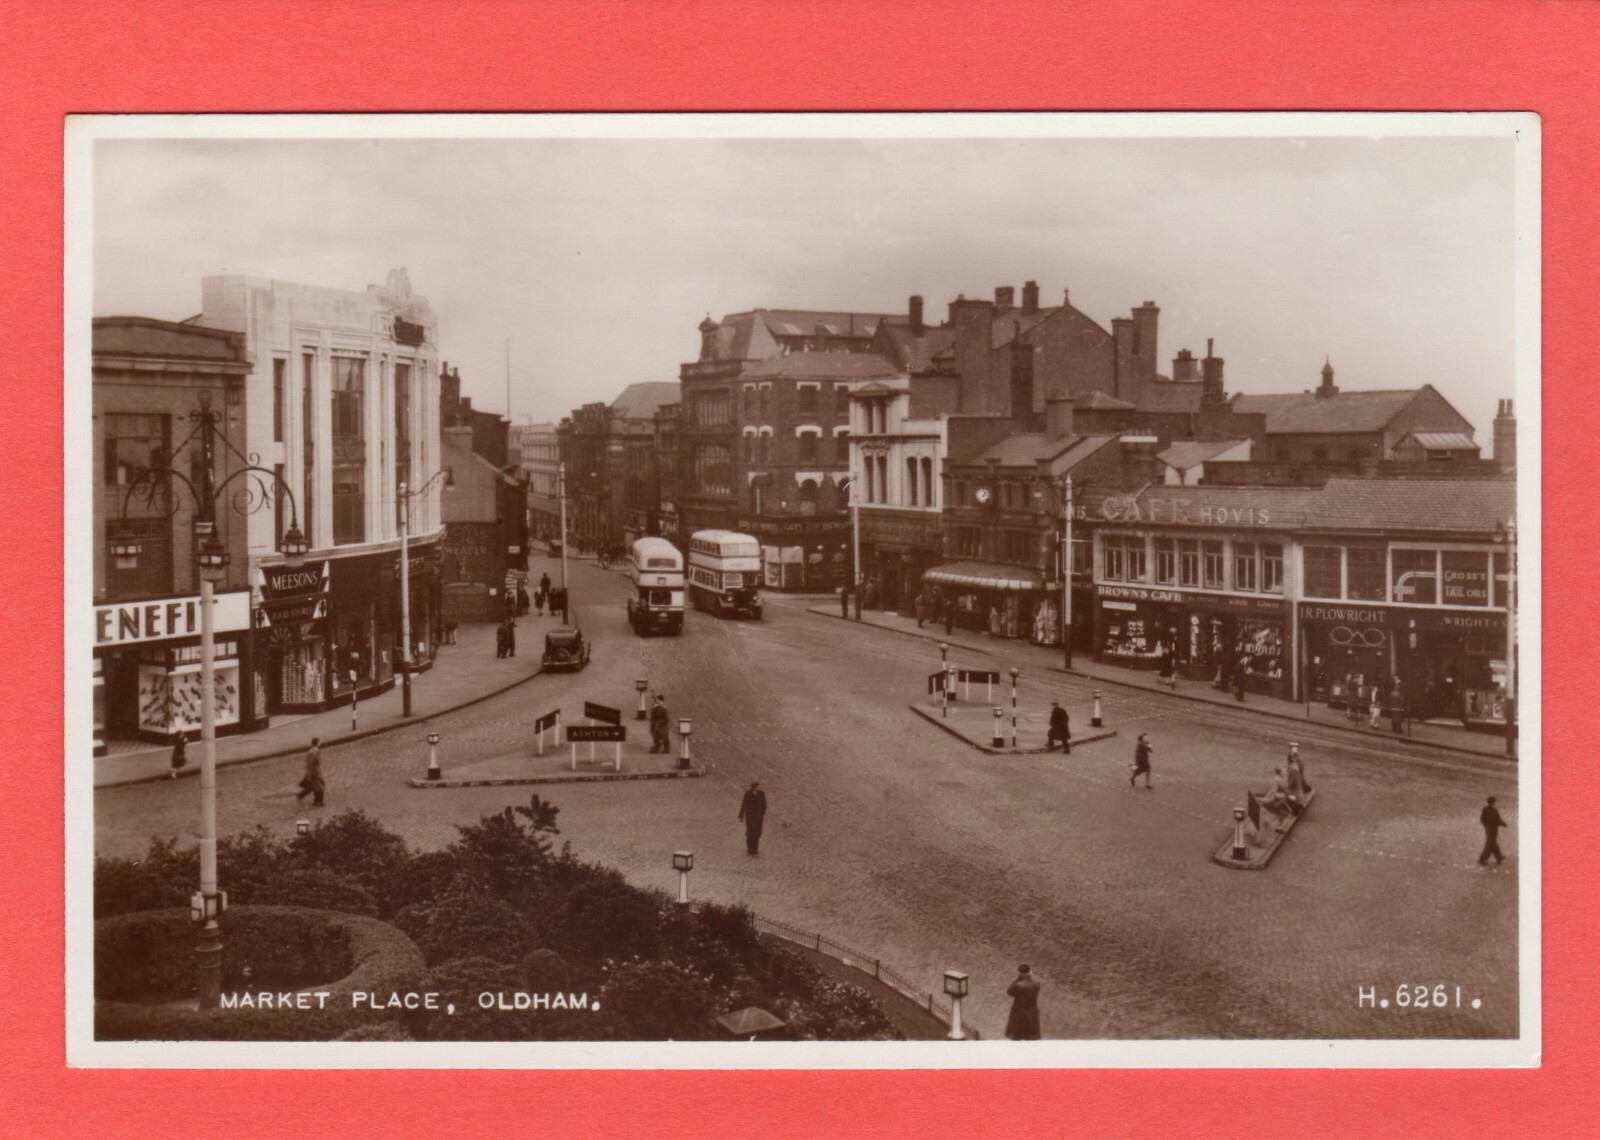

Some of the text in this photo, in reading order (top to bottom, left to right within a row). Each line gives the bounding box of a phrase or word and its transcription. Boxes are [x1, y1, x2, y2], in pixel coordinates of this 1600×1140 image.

[1103, 497, 1192, 523] CAFE
[1200, 509, 1269, 525] HOVIS
[271, 571, 318, 591] MEESONS
[1444, 586, 1487, 598] TAILORS
[1443, 616, 1490, 628] WRIGHT
[572, 730, 610, 738] ASHTON
